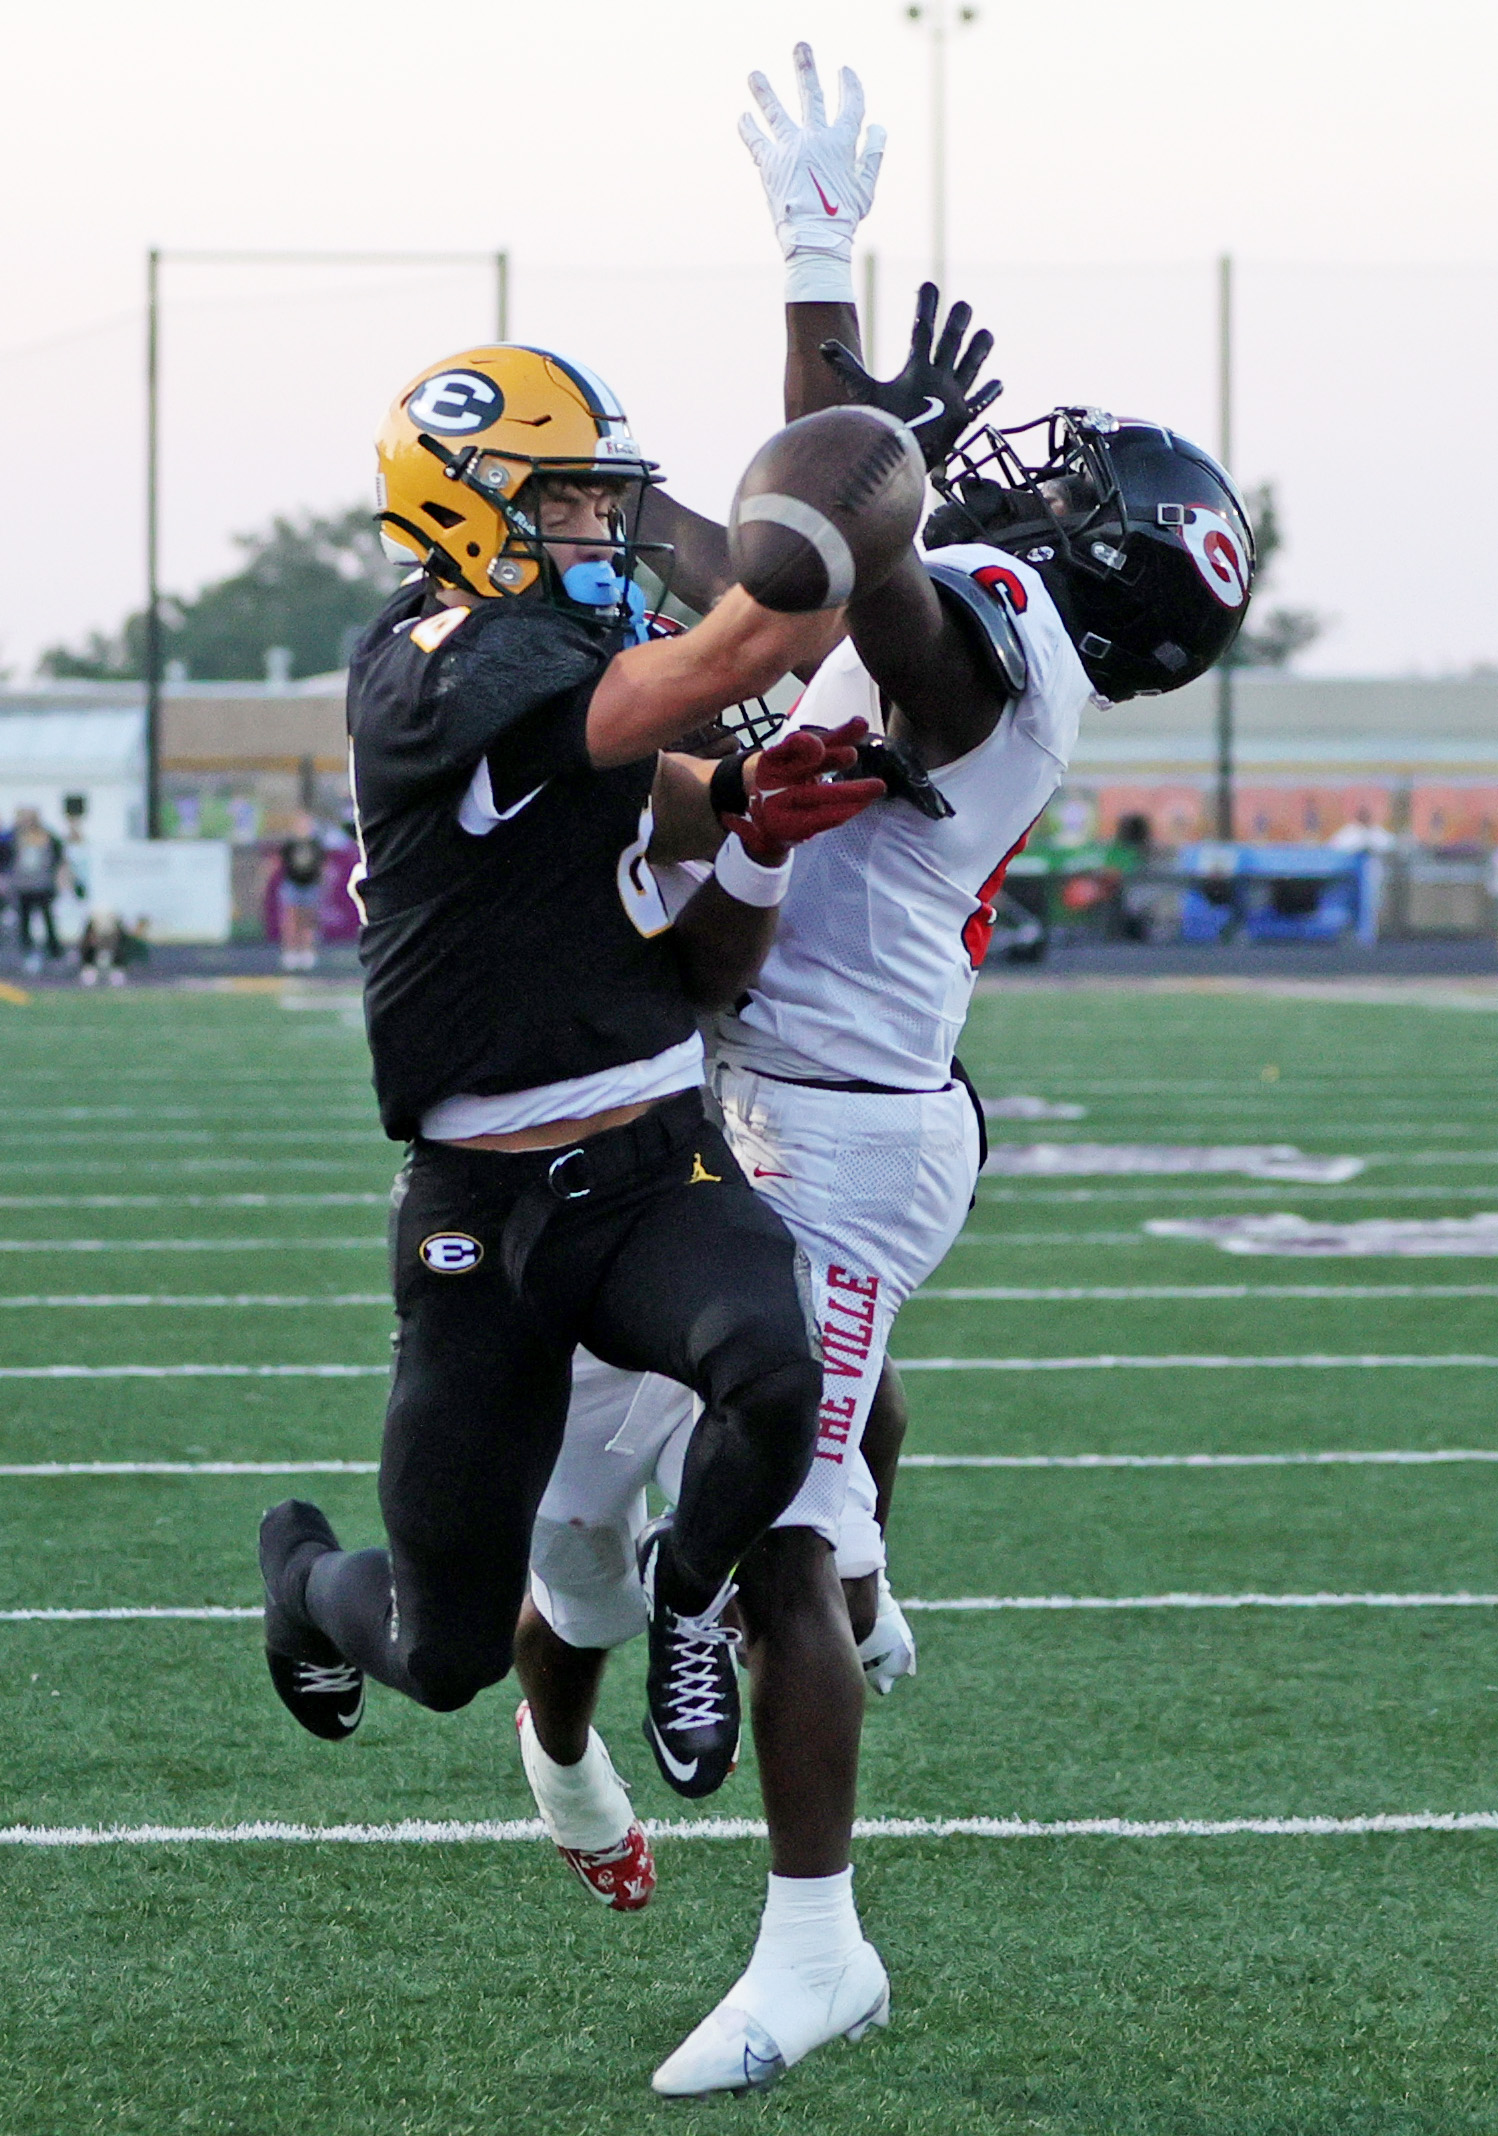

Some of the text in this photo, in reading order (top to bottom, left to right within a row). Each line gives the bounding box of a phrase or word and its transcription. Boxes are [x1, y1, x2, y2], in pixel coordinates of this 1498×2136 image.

[408, 373, 496, 431] E
[1180, 505, 1249, 608] G
[426, 1237, 477, 1270] E
[820, 1263, 880, 1379] VILLE
